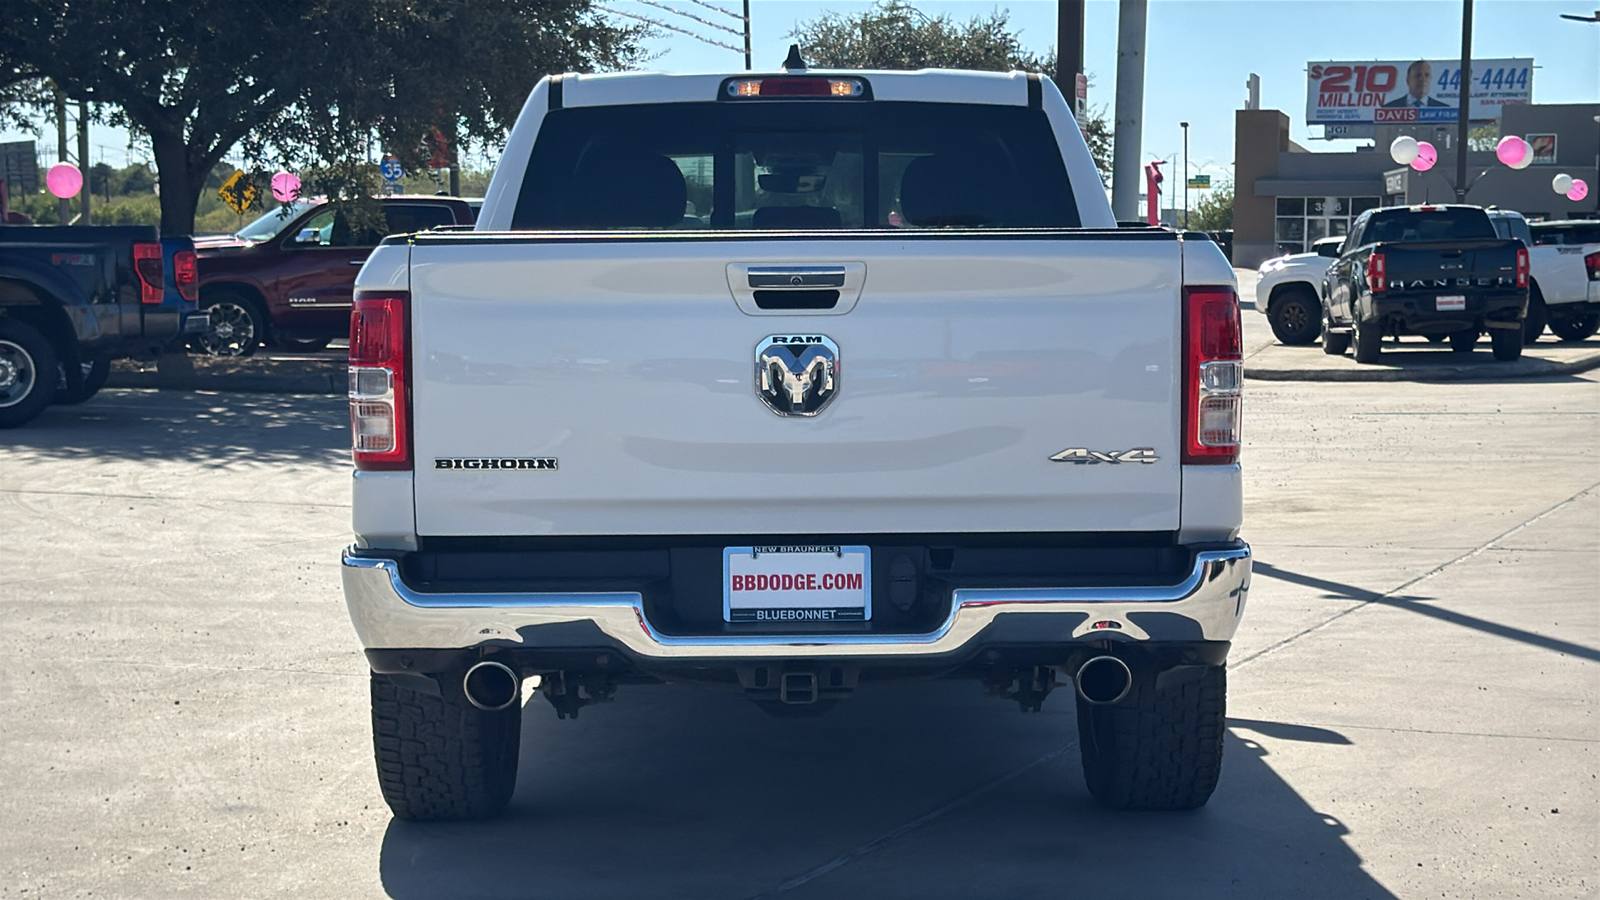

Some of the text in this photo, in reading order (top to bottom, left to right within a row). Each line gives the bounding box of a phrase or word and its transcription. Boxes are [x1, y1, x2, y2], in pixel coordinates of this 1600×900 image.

[1311, 64, 1397, 93] $210
[1437, 68, 1528, 90] 44-4444
[1318, 93, 1386, 107] MILLION
[1376, 110, 1416, 120] DAVIS
[384, 163, 403, 178] 35
[772, 336, 822, 344] RAM
[434, 457, 558, 470] BIGHORN
[780, 545, 840, 553] BRAUNFELS
[732, 573, 863, 591] BBDODGE.COM
[756, 609, 837, 620] BLUEBONNET
